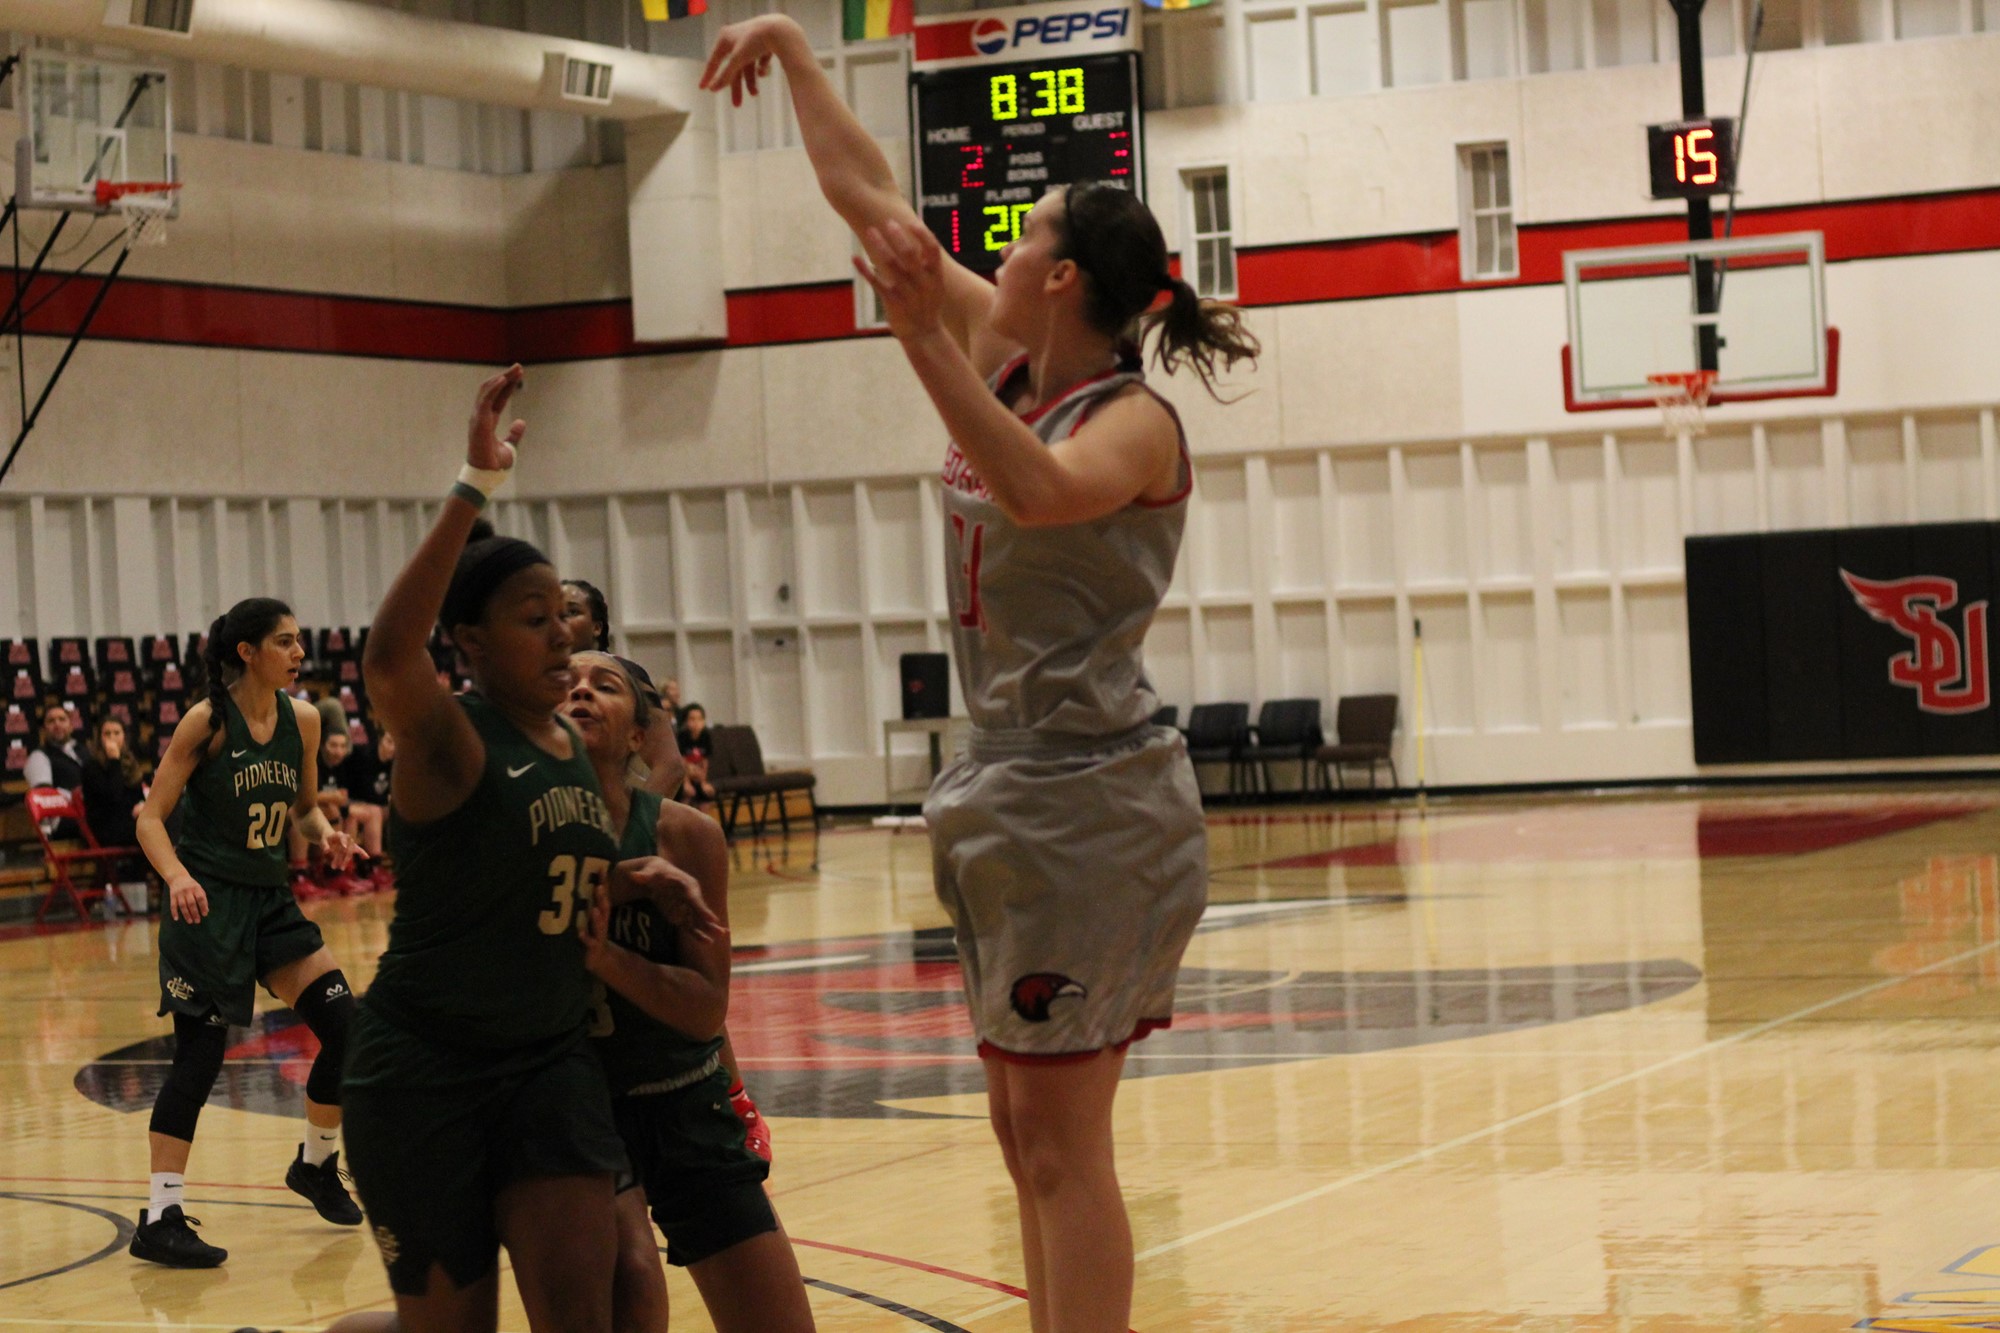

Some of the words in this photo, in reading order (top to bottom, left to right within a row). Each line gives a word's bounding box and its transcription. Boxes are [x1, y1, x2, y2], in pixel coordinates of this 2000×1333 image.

[1012, 9, 1129, 47] PEPSI
[927, 127, 971, 144] HOME
[1072, 111, 1126, 131] GUEST
[960, 145, 985, 188] 2
[1674, 129, 1717, 184] 15
[234, 760, 298, 798] PIONEERS
[246, 801, 288, 849] 20
[538, 854, 611, 936] 35
